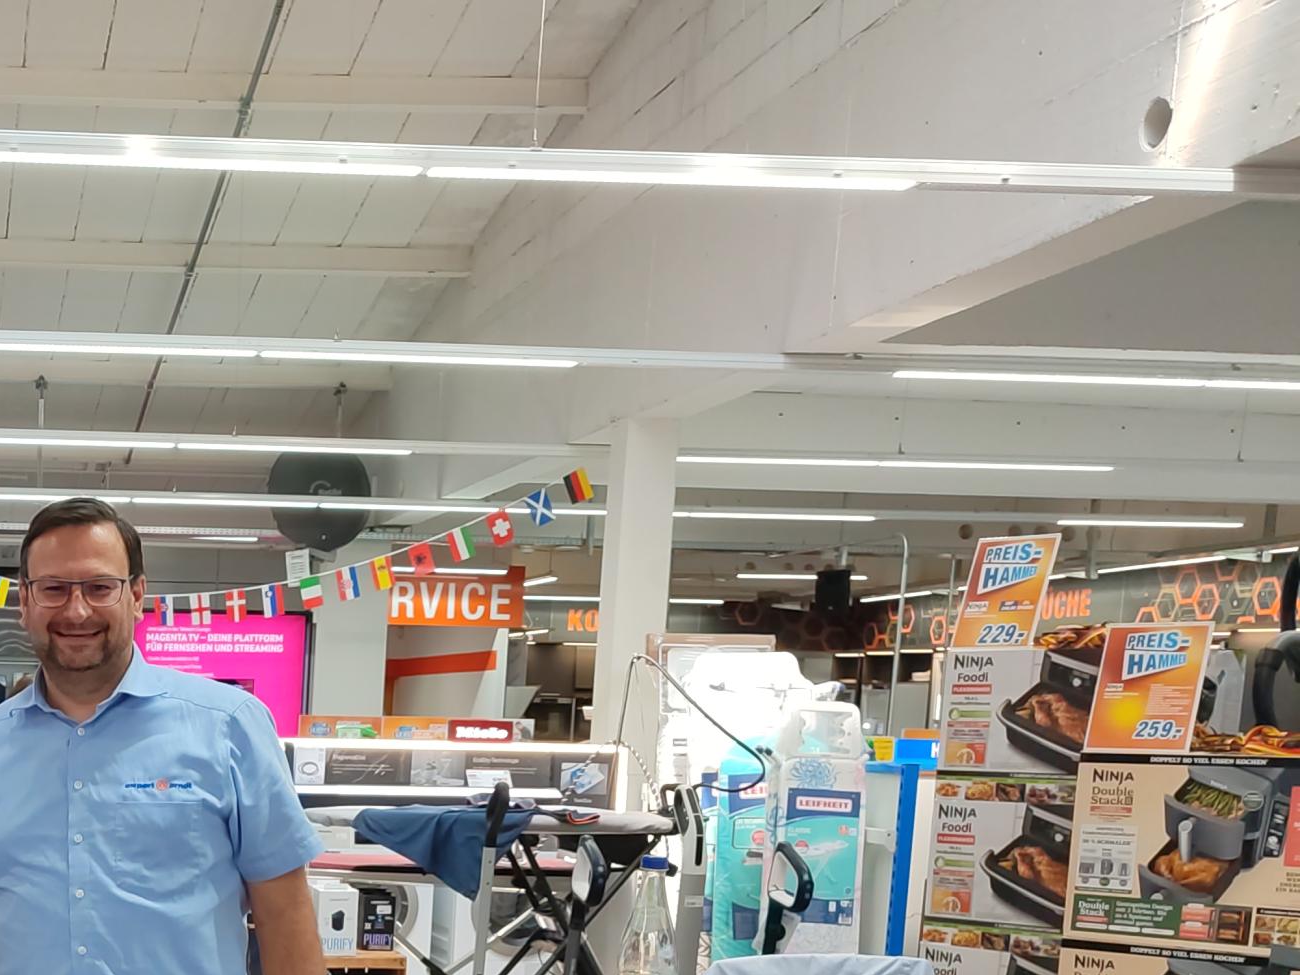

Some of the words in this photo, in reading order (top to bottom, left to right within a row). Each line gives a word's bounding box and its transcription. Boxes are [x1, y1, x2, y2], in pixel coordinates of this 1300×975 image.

[985, 543, 1042, 562] PREIS-
[390, 582, 512, 621] RVICE
[146, 633, 188, 642] MAGENTA
[188, 633, 200, 642] TV
[207, 634, 233, 643] DEINE
[234, 634, 284, 643] PLATTFORM
[1126, 632, 1190, 650] PREIS-
[146, 642, 162, 652] FÜR
[164, 643, 213, 652] FERNSEHEN
[214, 644, 233, 652] UND
[234, 644, 284, 653] STREAMING
[954, 655, 994, 671] NINJA
[957, 672, 989, 683] Foodi
[1093, 768, 1134, 785] NINJA
[1092, 786, 1134, 796] Double
[799, 799, 850, 810] LEIFHEIT
[1091, 795, 1125, 806] Stack
[938, 804, 977, 822] NINJA
[942, 822, 972, 833] Foodi
[1078, 900, 1110, 910] Double
[322, 937, 354, 951] PURIFY
[364, 933, 393, 946] PURIFY
[925, 947, 962, 966] NINJA
[1074, 954, 1115, 972] NINJA
